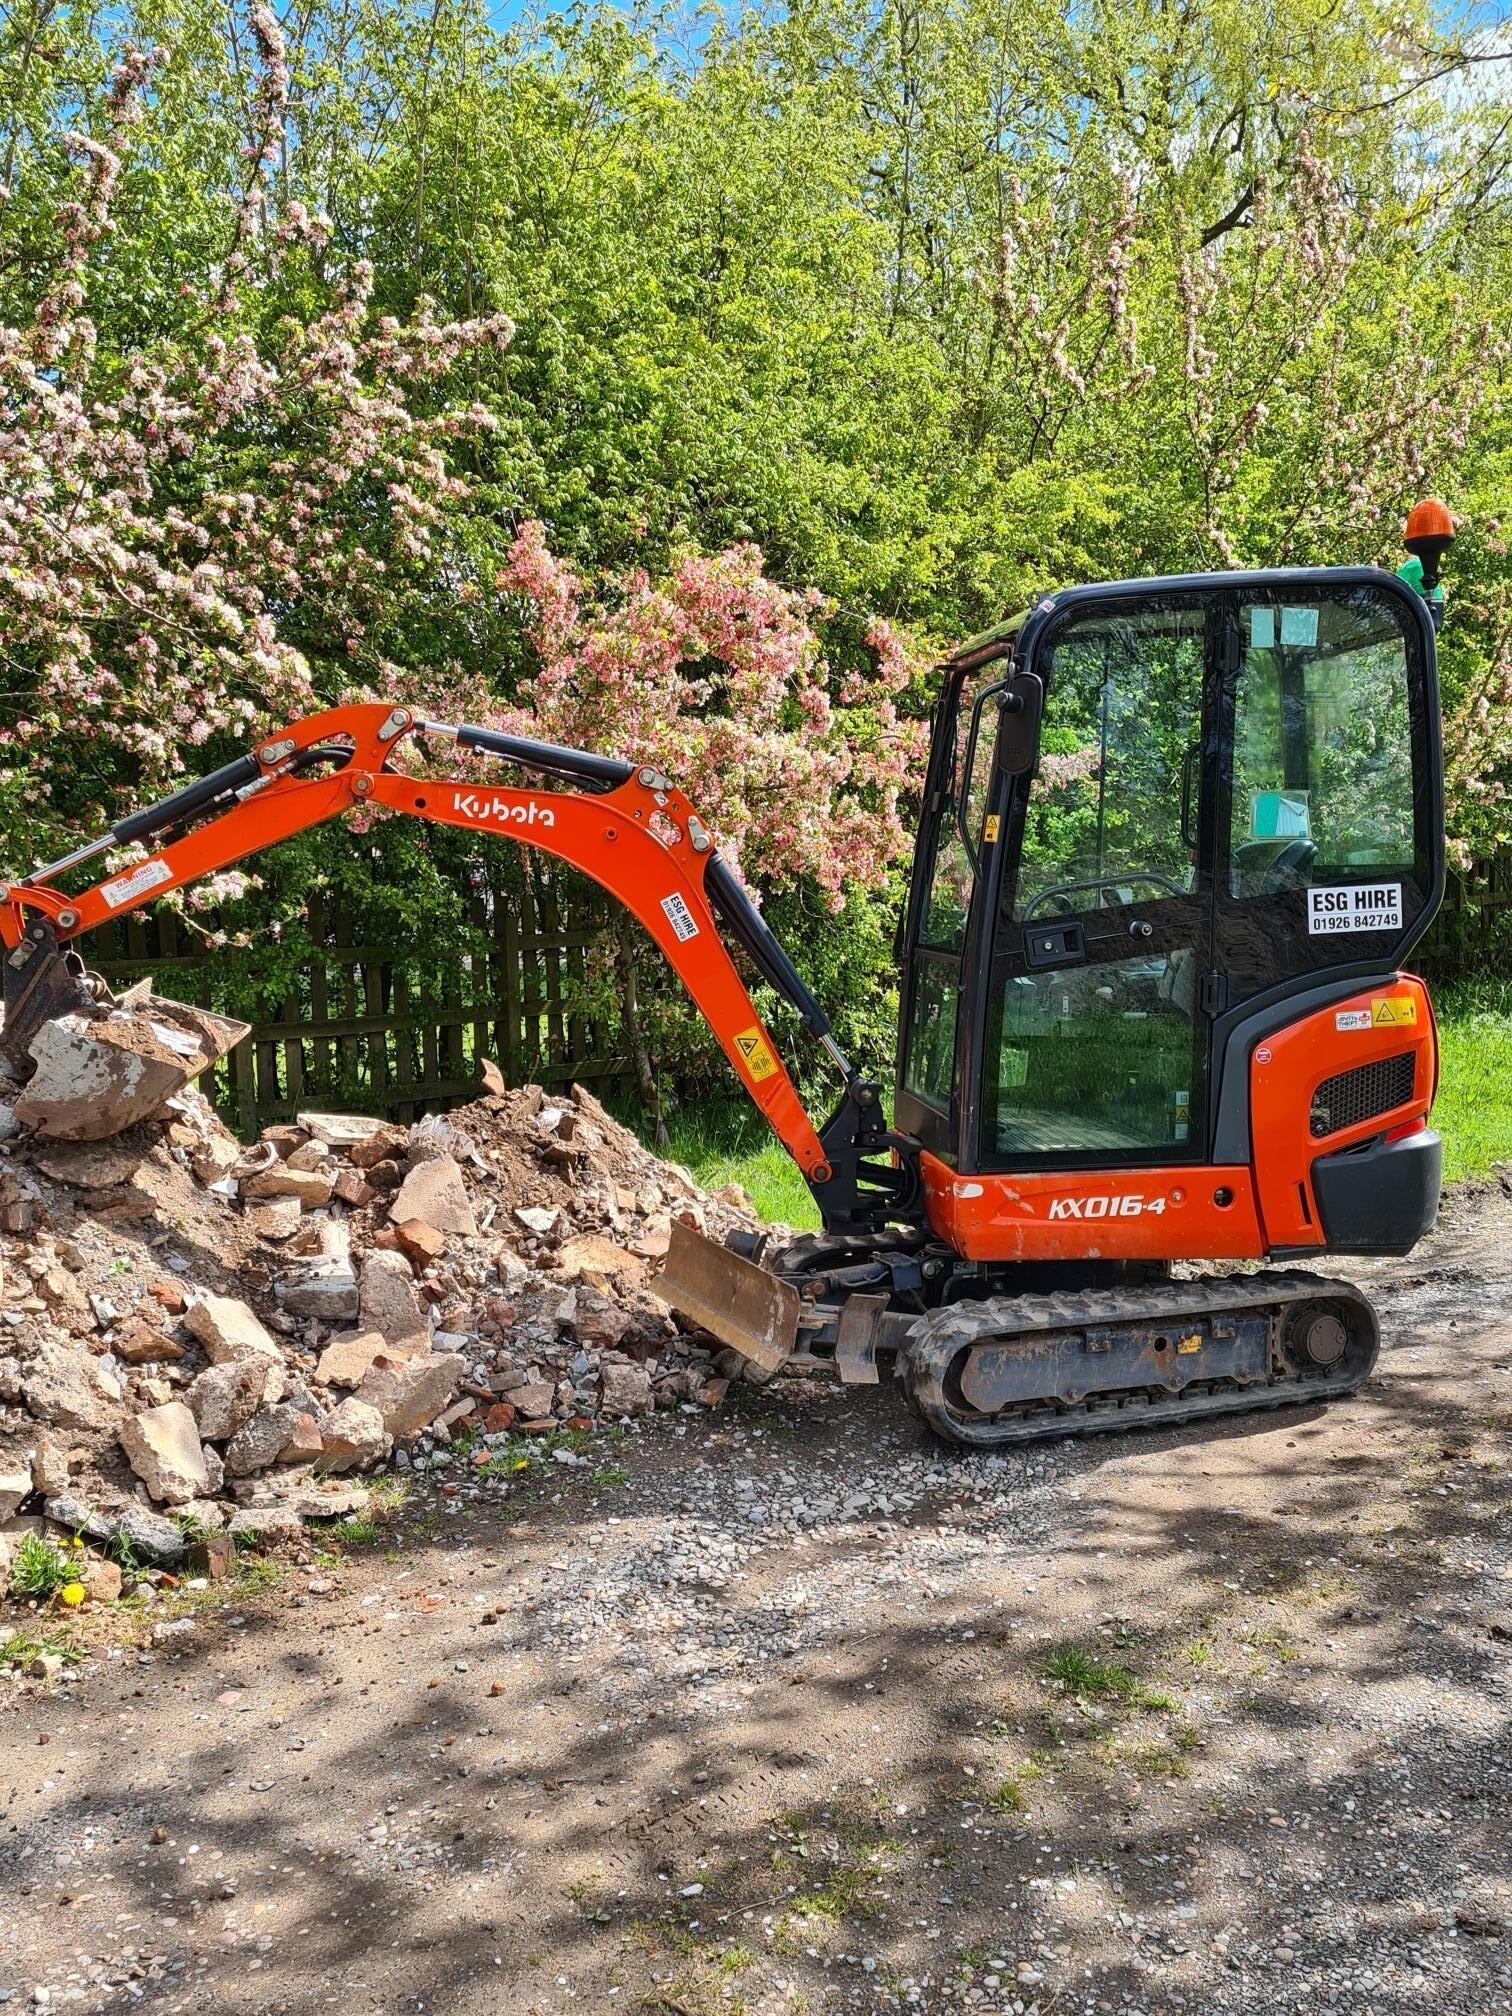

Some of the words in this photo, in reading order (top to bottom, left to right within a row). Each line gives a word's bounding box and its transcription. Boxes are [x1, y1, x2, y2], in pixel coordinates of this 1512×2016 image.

[454, 793, 555, 827] Kubota
[114, 866, 153, 890] WANING
[662, 900, 676, 919] 01926
[1313, 892, 1348, 912] ESG
[1354, 889, 1397, 910] HIRE
[670, 895, 685, 914] ESG
[680, 913, 697, 936] HIRE
[1313, 916, 1350, 931] 01926
[1354, 913, 1399, 928] 842749
[1048, 1195, 1166, 1220] KX016-4
